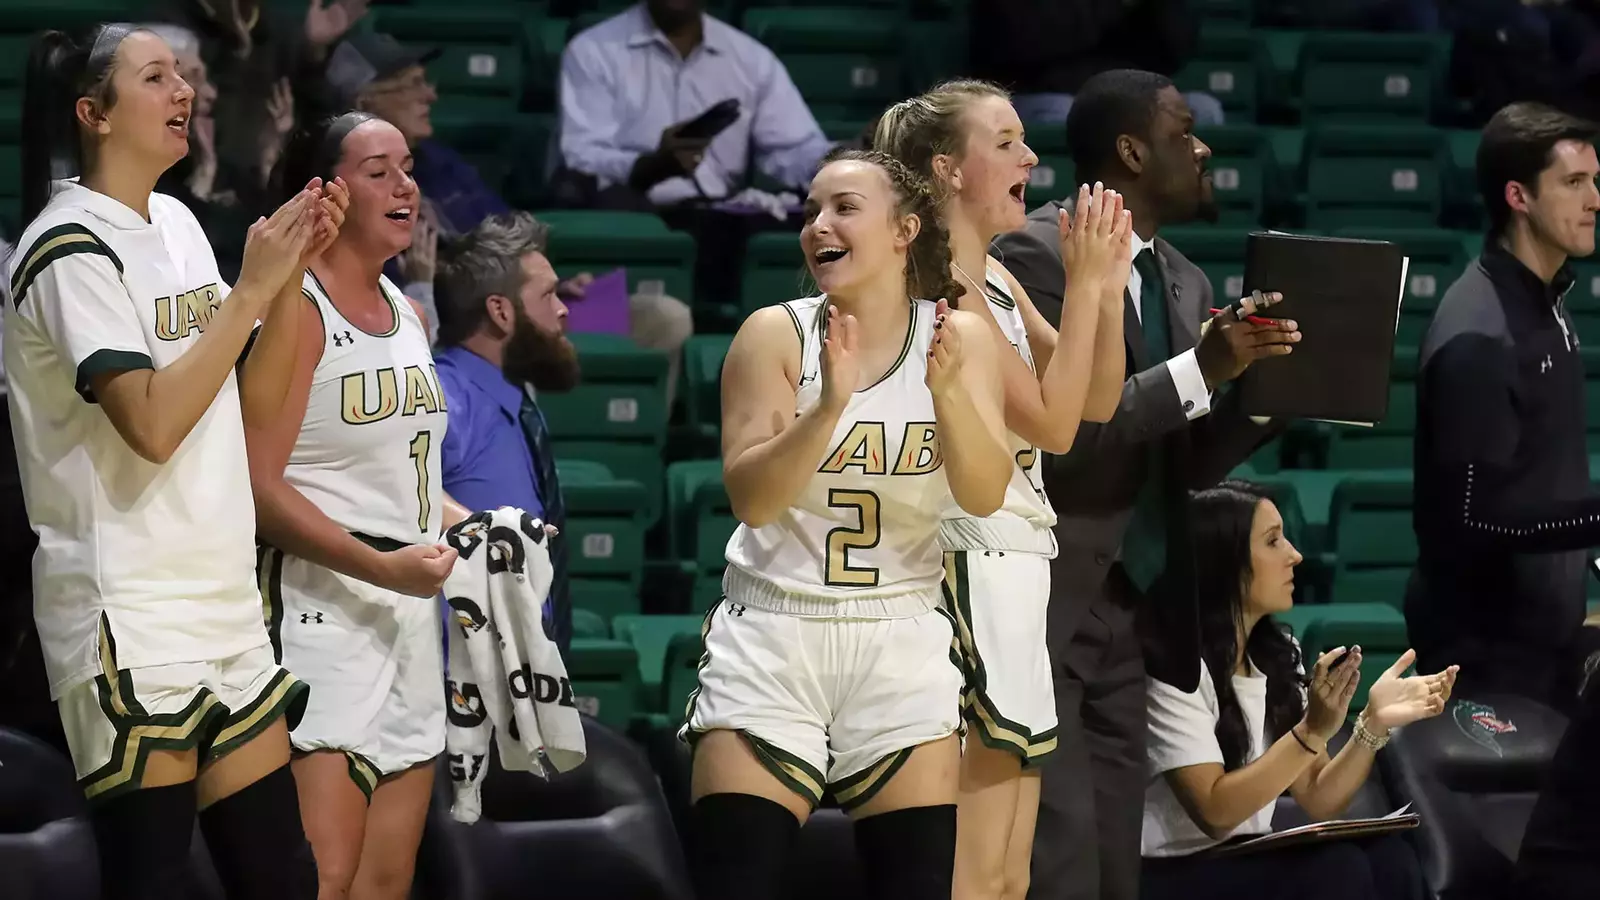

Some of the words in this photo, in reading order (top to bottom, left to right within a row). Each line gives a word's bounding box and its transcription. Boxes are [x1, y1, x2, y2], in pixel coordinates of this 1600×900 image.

[409, 430, 431, 534] 1
[817, 421, 943, 476] AB
[825, 488, 881, 587] 2
